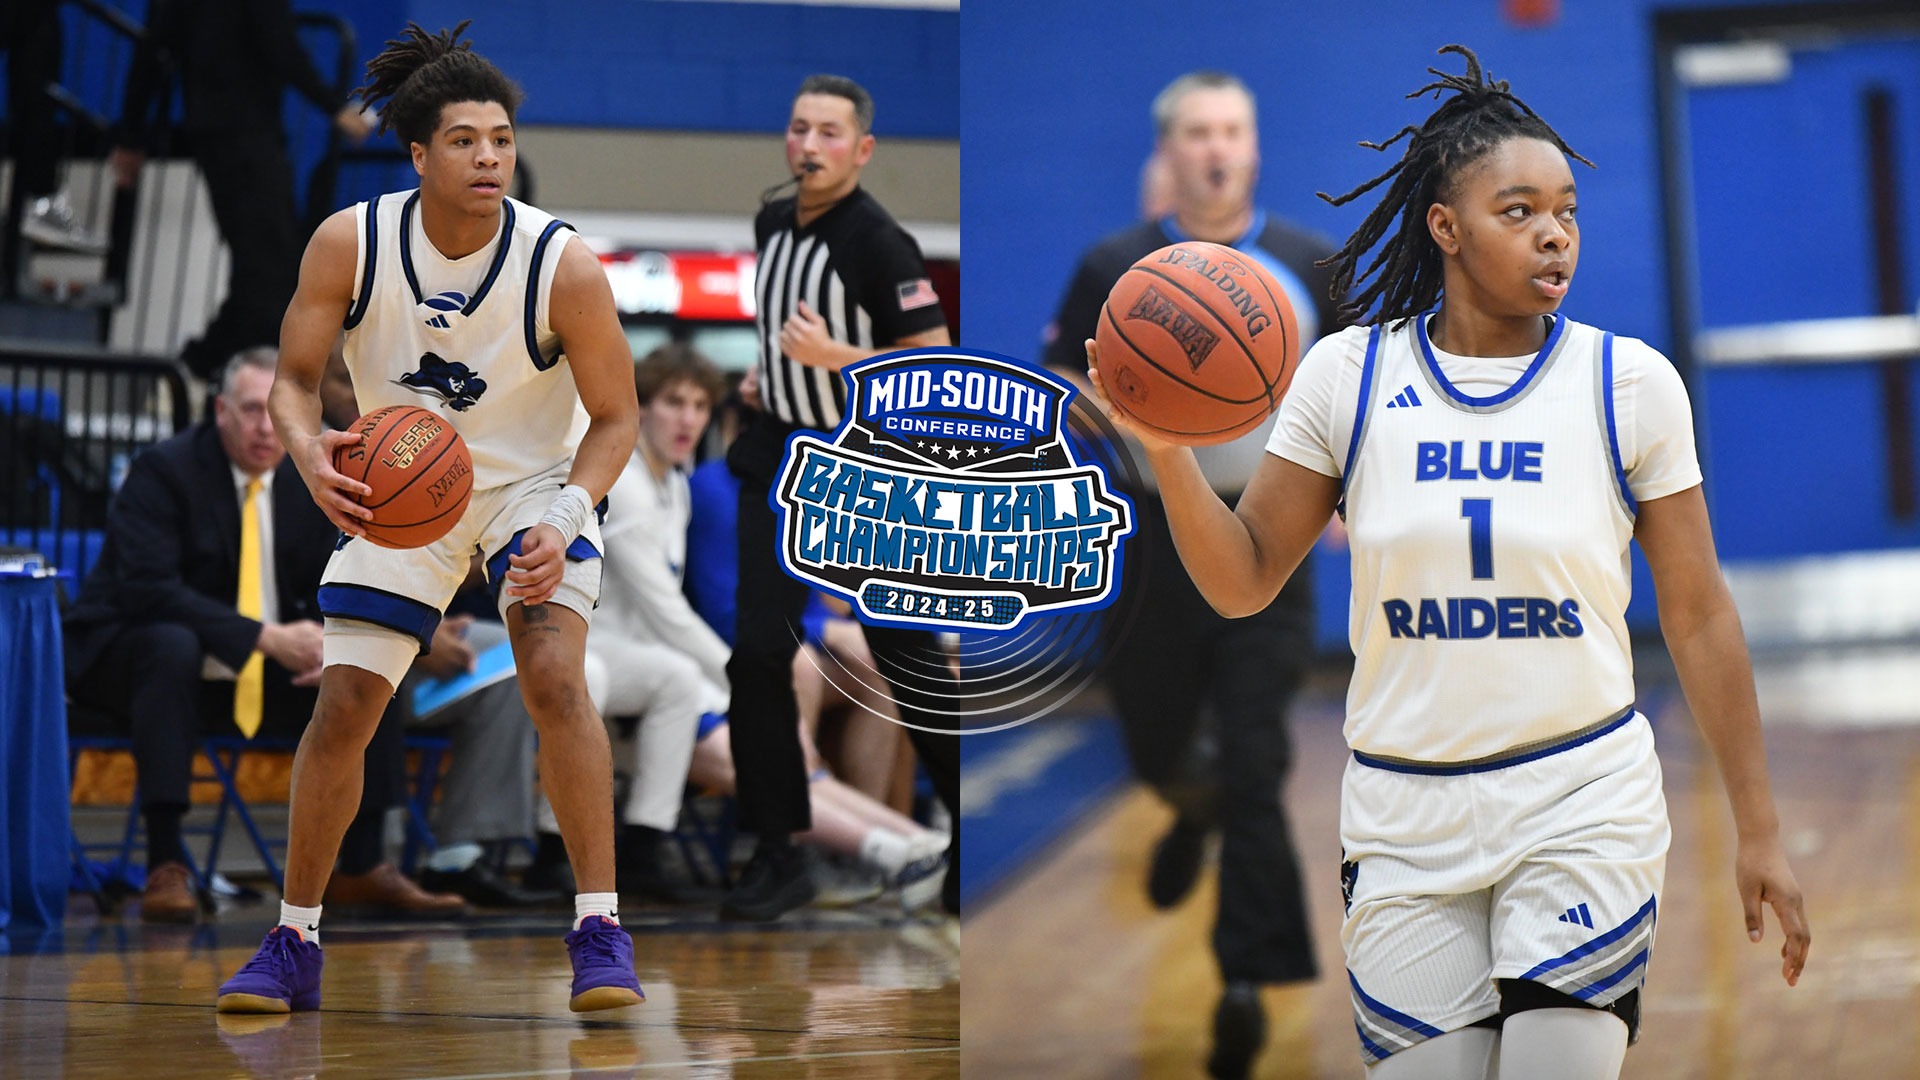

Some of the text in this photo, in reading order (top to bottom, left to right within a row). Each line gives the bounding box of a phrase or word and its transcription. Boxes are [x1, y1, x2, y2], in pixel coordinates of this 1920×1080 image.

[1159, 248, 1271, 338] SPALDING
[382, 414, 437, 468] LEGACY
[1415, 440, 1545, 483] BLUE
[1459, 497, 1495, 581] 1
[1382, 596, 1585, 640] RAIDERS
